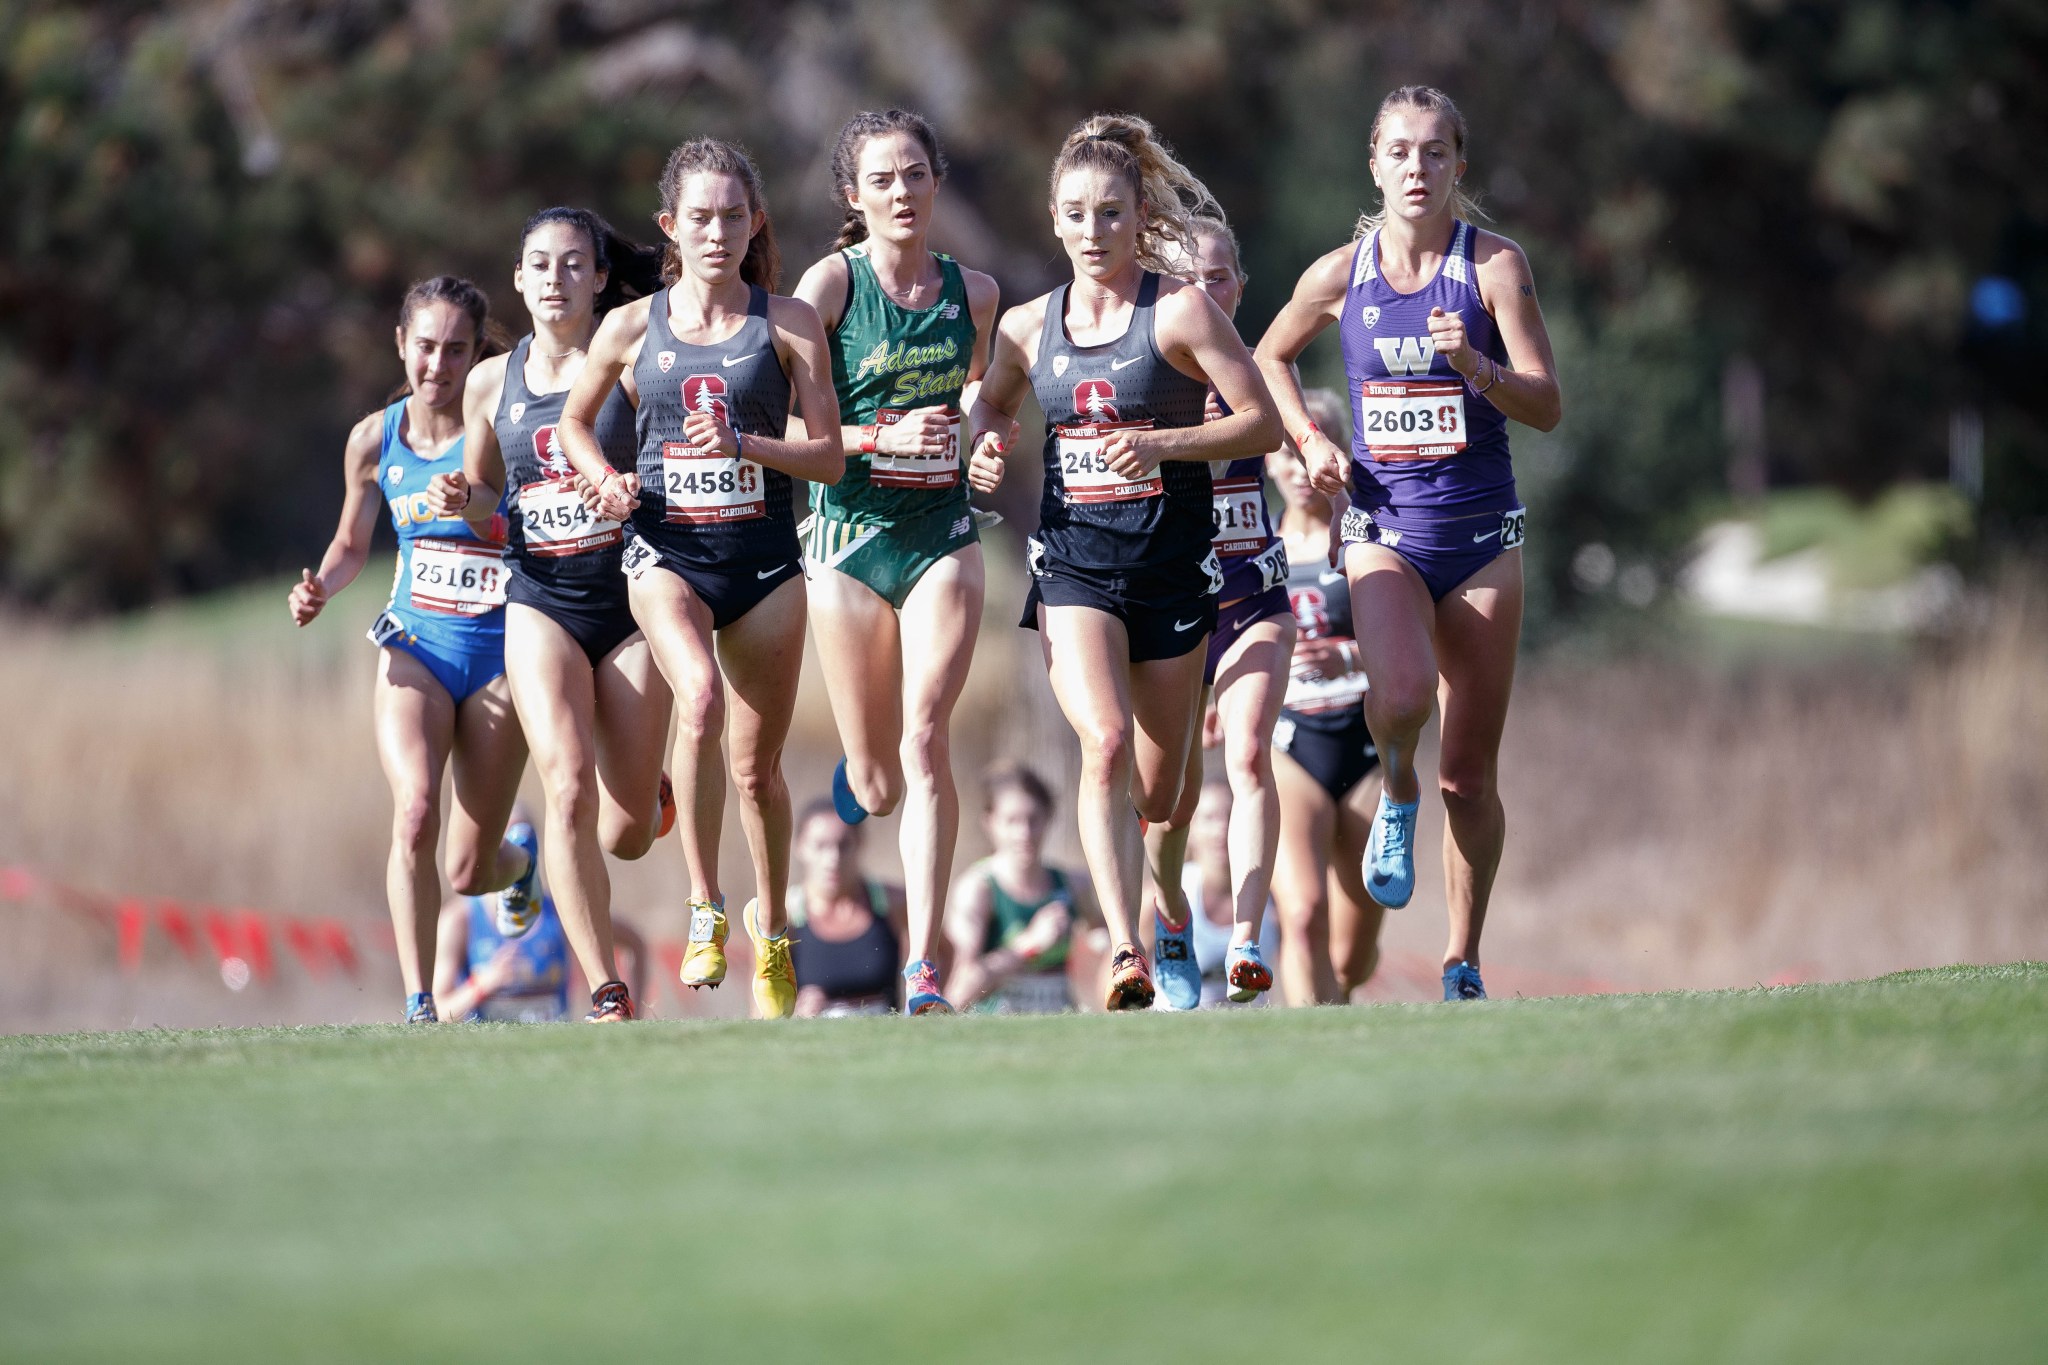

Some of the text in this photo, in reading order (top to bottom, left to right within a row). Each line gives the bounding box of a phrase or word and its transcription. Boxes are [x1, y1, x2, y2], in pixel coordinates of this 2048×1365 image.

[857, 337, 958, 380] Adams
[1374, 337, 1435, 377] W
[890, 365, 966, 405] State
[1369, 386, 1406, 395] STANFORD
[1368, 410, 1434, 432] 2603
[1064, 428, 1098, 437] STANFORD
[1418, 445, 1457, 455] CARDINAL
[1065, 451, 1110, 474] 245
[668, 471, 735, 494] 2458
[1115, 483, 1154, 495] CARDINAL
[389, 491, 463, 528] UC
[527, 503, 590, 530] 2454
[720, 505, 756, 517] CARDINAL
[578, 532, 615, 548] CARDINAL
[1223, 541, 1260, 552] CARDINAL
[1379, 528, 1403, 547] W
[416, 562, 476, 588] 2516
